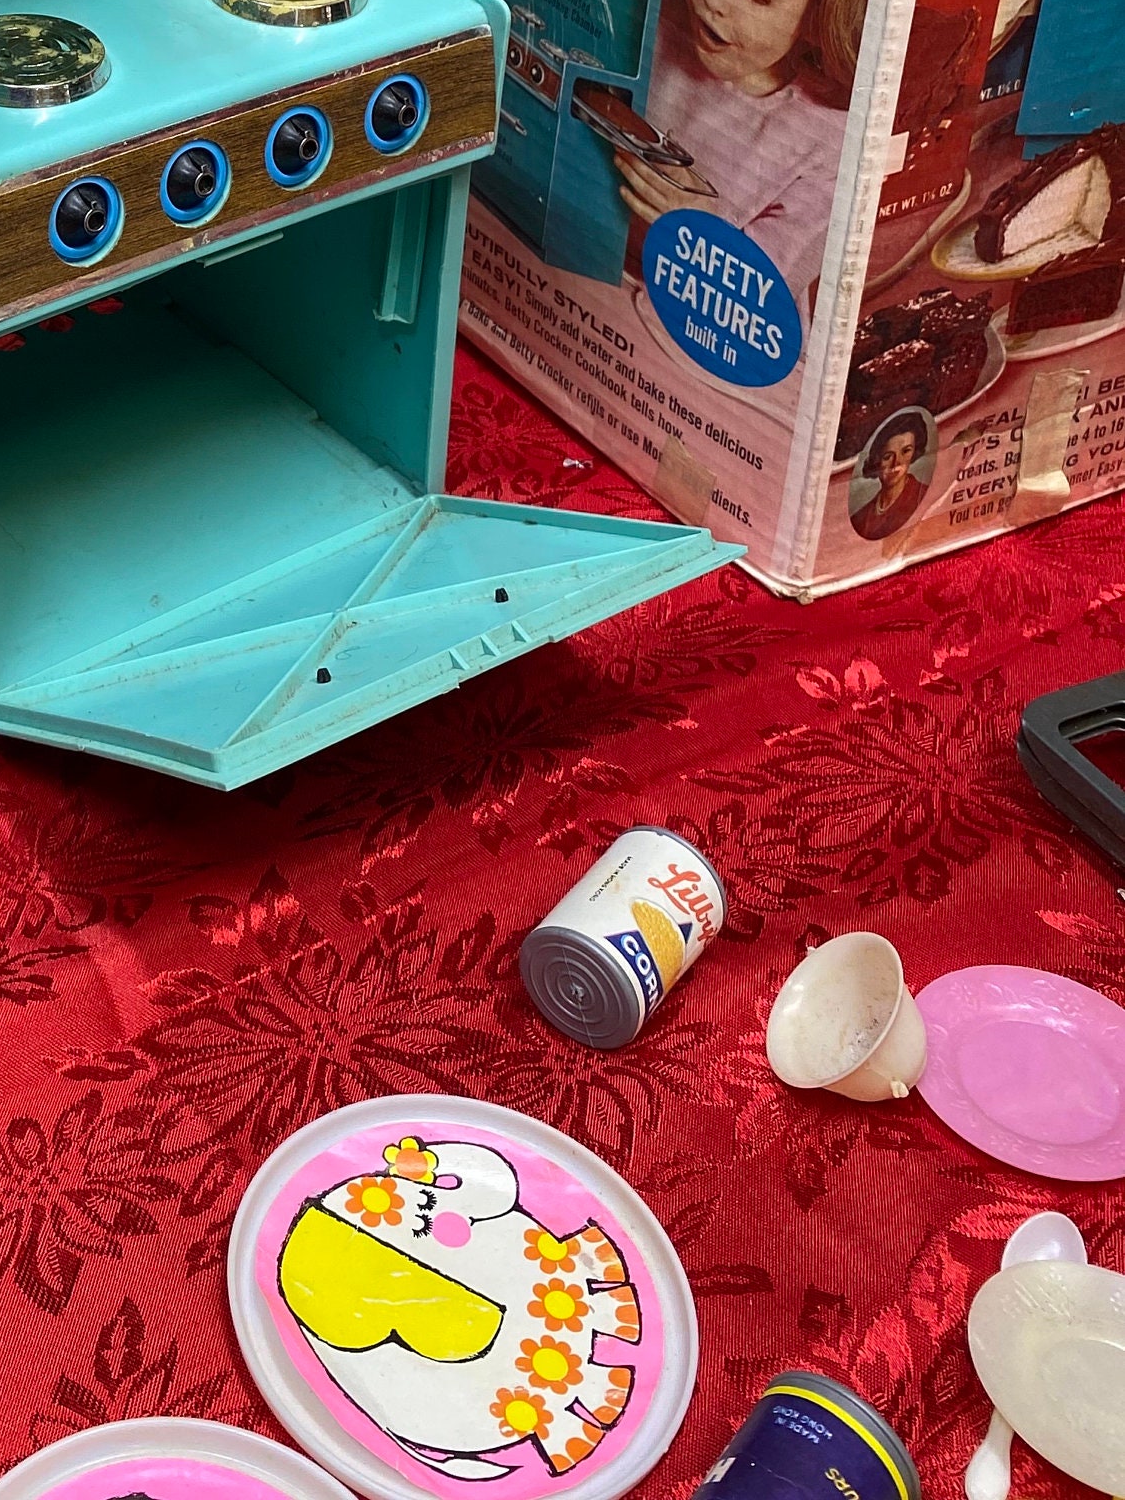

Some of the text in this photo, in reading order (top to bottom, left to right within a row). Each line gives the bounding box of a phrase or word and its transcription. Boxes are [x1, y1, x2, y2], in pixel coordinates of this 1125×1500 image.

[878, 202, 898, 218] NET
[940, 183, 953, 197] OZ
[465, 223, 634, 358] UTIFULLY STYLED!
[675, 225, 774, 308] SAFETY
[653, 254, 783, 359] FEATURES
[472, 250, 764, 471] EASY! Simply add water and bake these delicious
[685, 316, 737, 367] built in
[505, 298, 531, 329] Betty
[534, 318, 573, 359] Crocker
[575, 353, 627, 401] Cookbook
[631, 395, 655, 423] tells
[658, 412, 686, 445] how.
[509, 333, 535, 364] Betty
[536, 352, 573, 395] Crocker
[577, 386, 604, 420] refills
[607, 414, 619, 430] or
[620, 424, 638, 445] use
[1082, 428, 1090, 443] 4
[1094, 423, 1106, 439] to
[712, 488, 752, 528] dients.
[948, 508, 969, 526] You
[974, 502, 993, 518] can
[773, 1405, 833, 1439] HONG KONG
[788, 1421, 819, 1444] MADE
